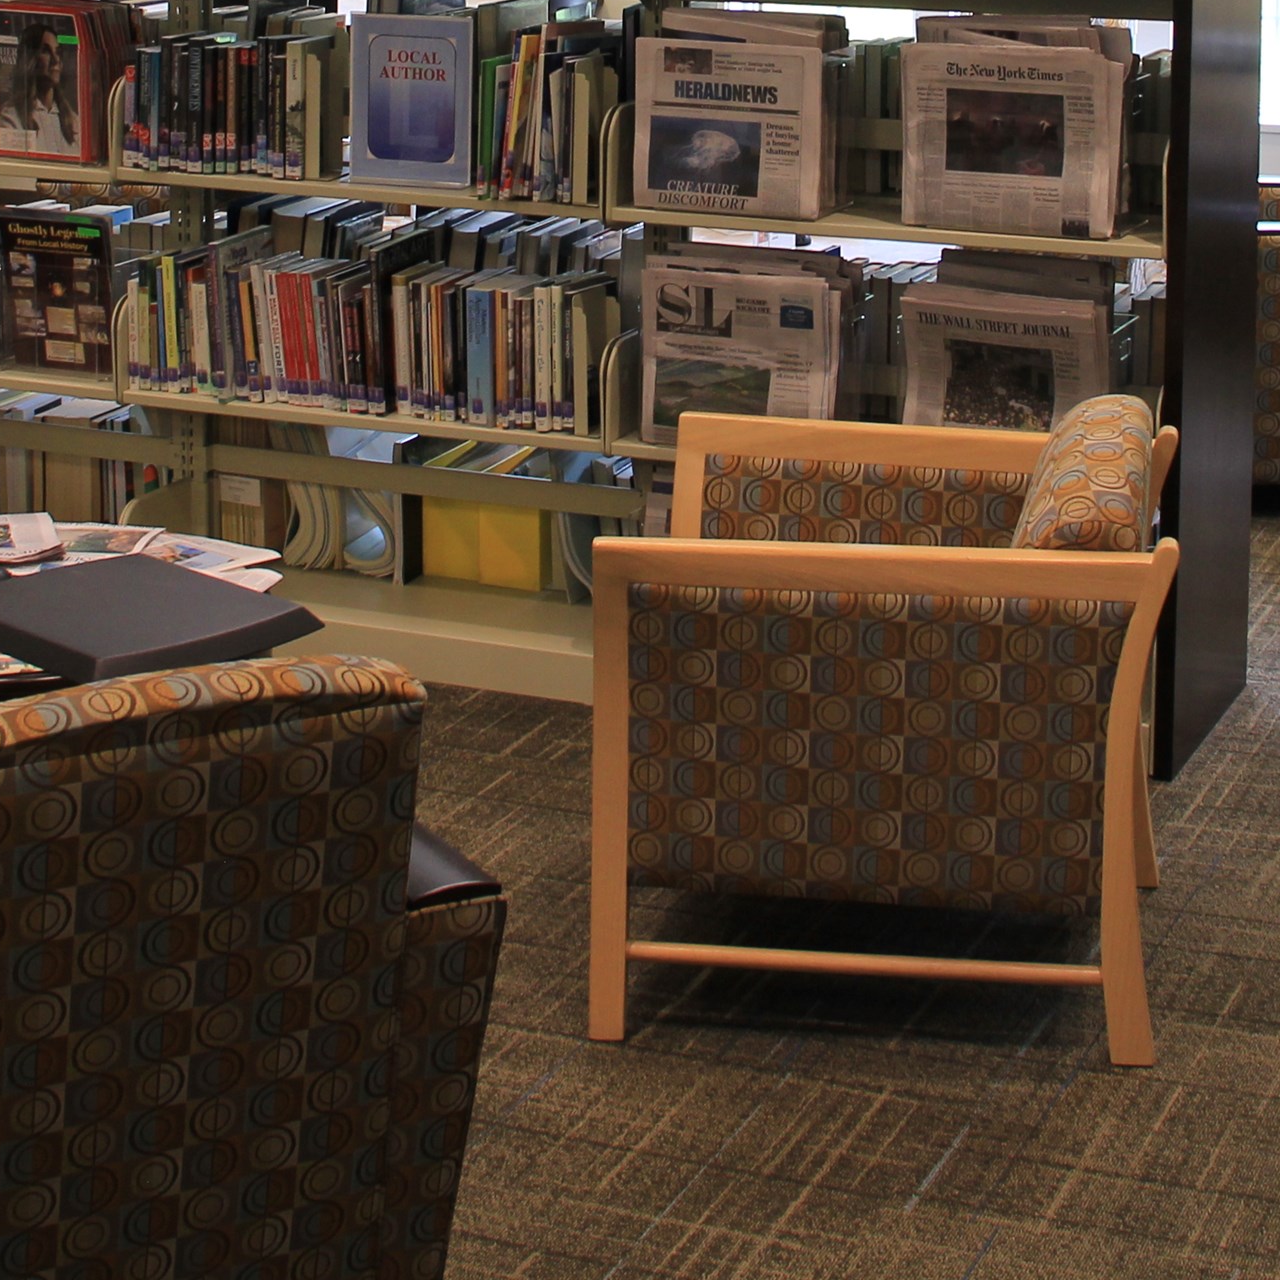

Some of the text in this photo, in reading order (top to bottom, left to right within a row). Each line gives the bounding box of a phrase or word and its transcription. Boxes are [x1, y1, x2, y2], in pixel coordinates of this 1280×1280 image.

[0, 47, 18, 57] HER
[387, 49, 442, 65] LOCAL
[379, 66, 446, 82] AUTHOR
[946, 62, 1064, 82] The New York Times
[674, 80, 778, 105] HERALDNEWS
[766, 123, 794, 131] Dreams
[772, 140, 791, 148] home
[775, 132, 800, 141] buying
[765, 148, 800, 157] shattered
[667, 179, 739, 196] CREATURE
[658, 192, 748, 210] DISCOMFORT
[8, 223, 48, 236] Ghostly
[17, 238, 88, 251] From Local History
[656, 283, 732, 328] SL
[917, 311, 1074, 339] THE WALL STREET JOURNAL
